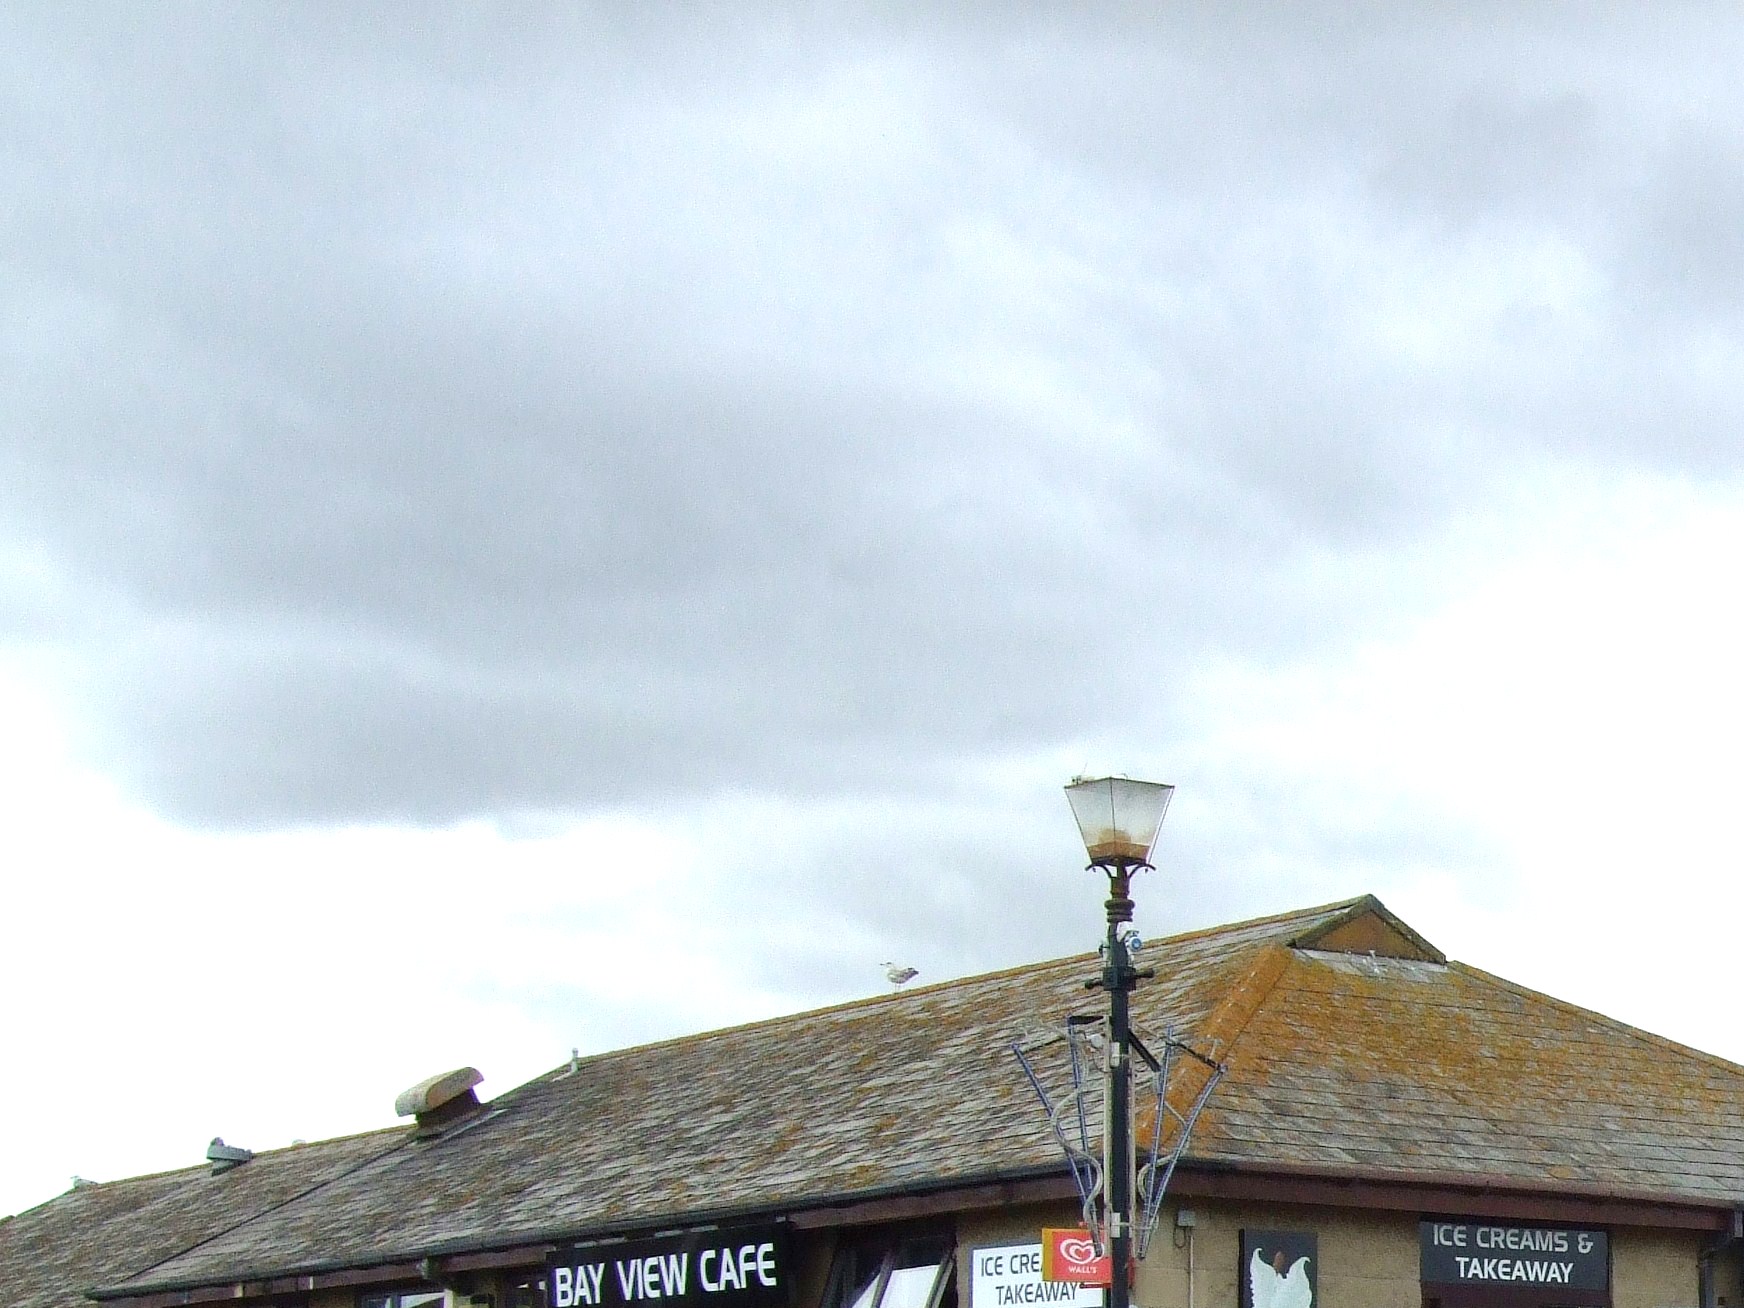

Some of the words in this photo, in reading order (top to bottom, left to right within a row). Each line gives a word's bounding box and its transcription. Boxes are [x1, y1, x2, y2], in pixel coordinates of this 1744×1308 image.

[1433, 1225, 1467, 1247] ICE
[1476, 1227, 1569, 1253] CREAMS
[1577, 1233, 1594, 1254] &
[554, 1262, 606, 1308] BAY
[616, 1252, 688, 1301] VIEW
[700, 1242, 778, 1292] CAFE
[980, 1256, 1004, 1278] ICE
[1010, 1252, 1043, 1276] CRE
[1068, 1265, 1098, 1275] WALL'S
[1454, 1256, 1575, 1284] TAKEAWAY
[995, 1282, 1078, 1306] TAKEAWAY
